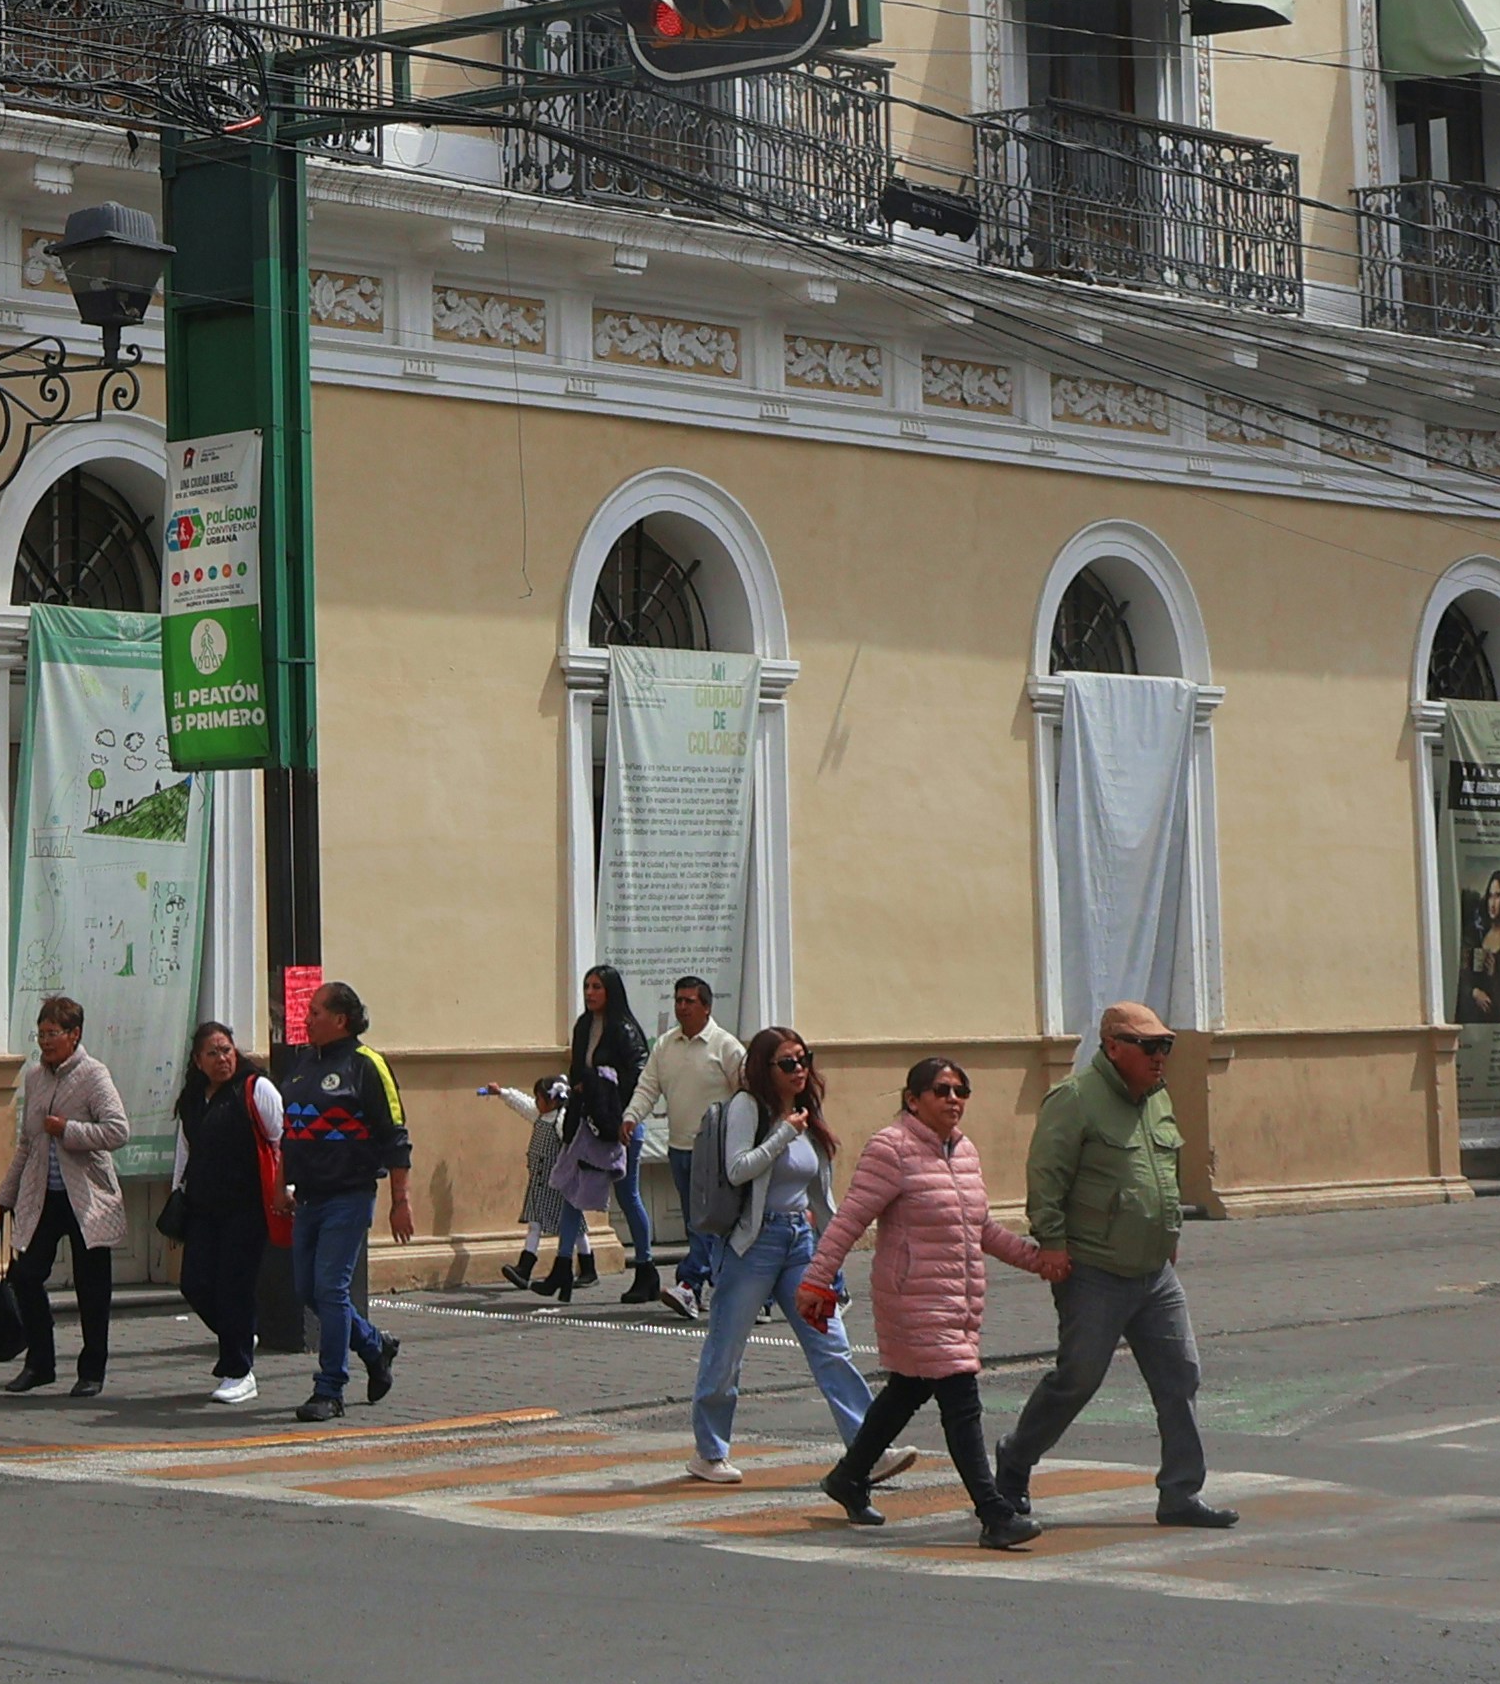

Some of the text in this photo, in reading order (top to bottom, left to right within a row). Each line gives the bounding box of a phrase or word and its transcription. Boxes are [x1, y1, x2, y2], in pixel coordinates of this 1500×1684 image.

[206, 505, 257, 525] POLÍGONO
[206, 521, 257, 536] CONVIVENCIA
[206, 533, 238, 546] URBANA
[188, 679, 259, 707] PEATÓN
[695, 685, 743, 709] CIUDAD
[185, 707, 266, 731] PRIMERO
[713, 710, 726, 730] DE
[688, 731, 747, 756] COLORES
